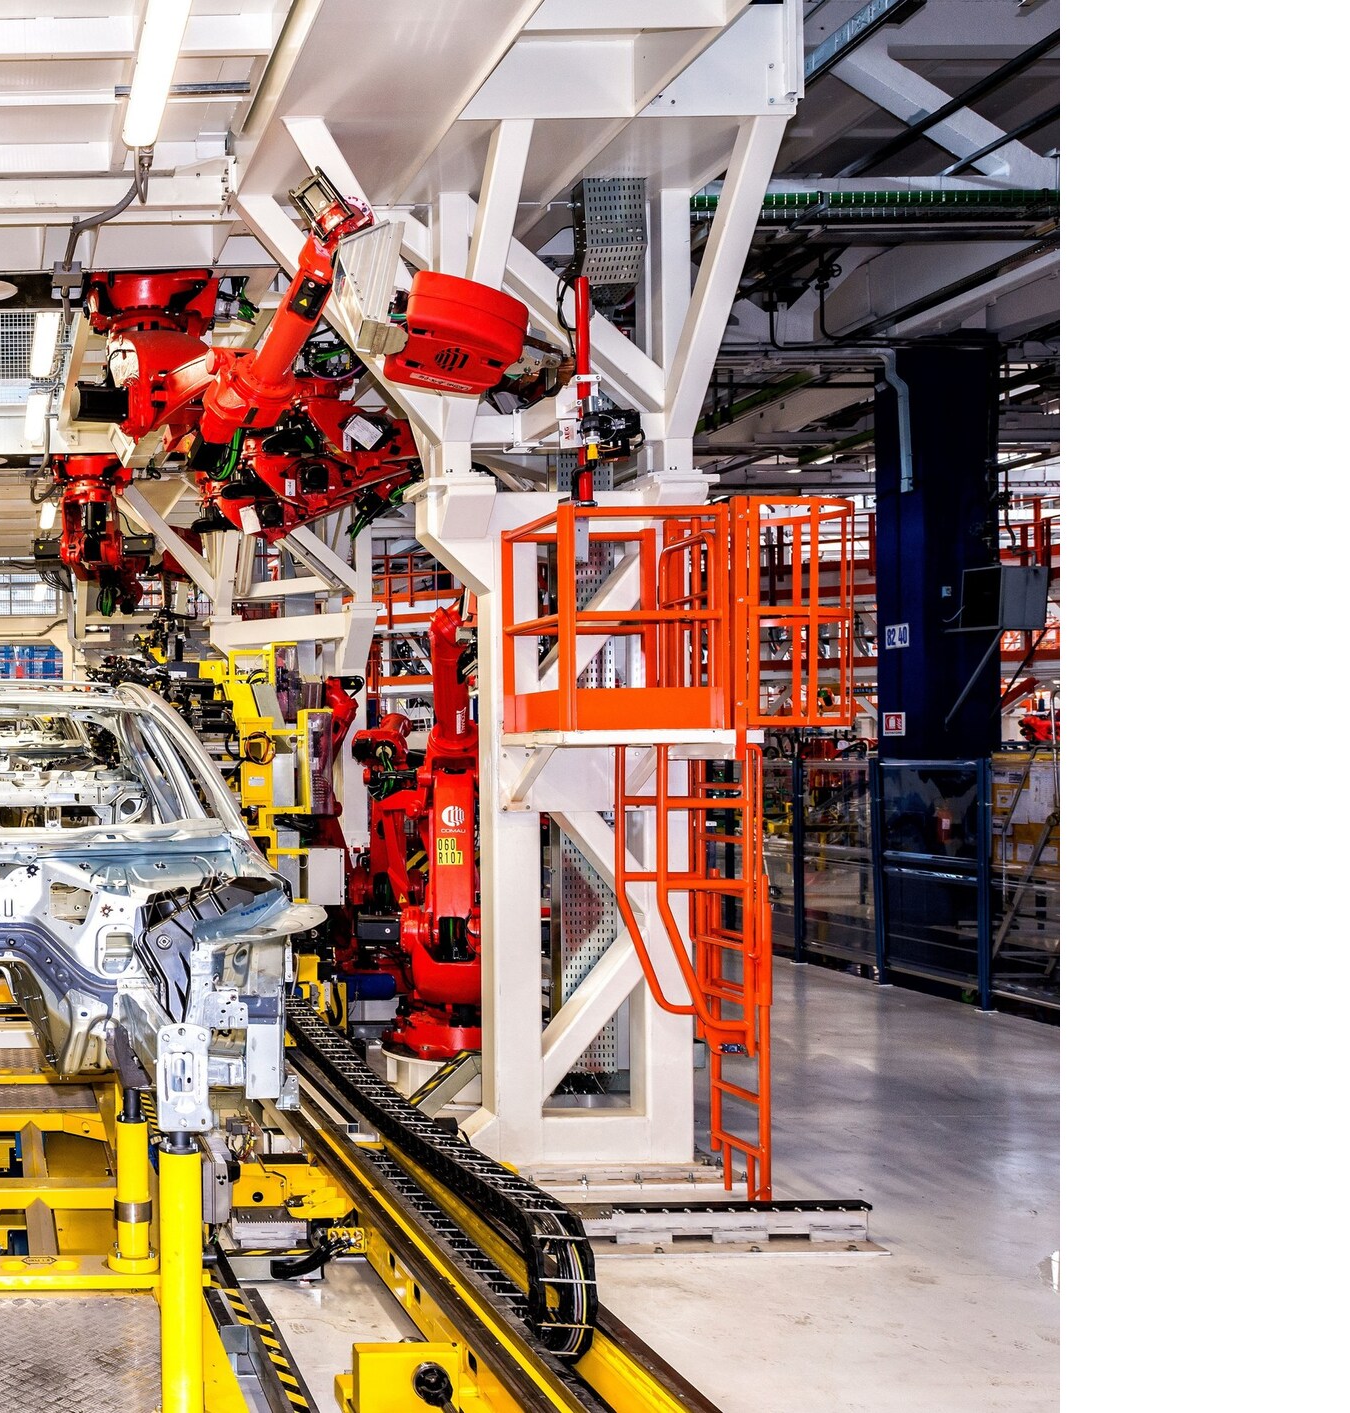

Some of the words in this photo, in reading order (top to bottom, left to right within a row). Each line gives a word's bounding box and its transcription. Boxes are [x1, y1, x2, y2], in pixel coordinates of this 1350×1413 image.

[887, 628, 896, 646] 82
[898, 626, 907, 645] 40
[438, 838, 456, 851] 060
[438, 852, 462, 864] R107
